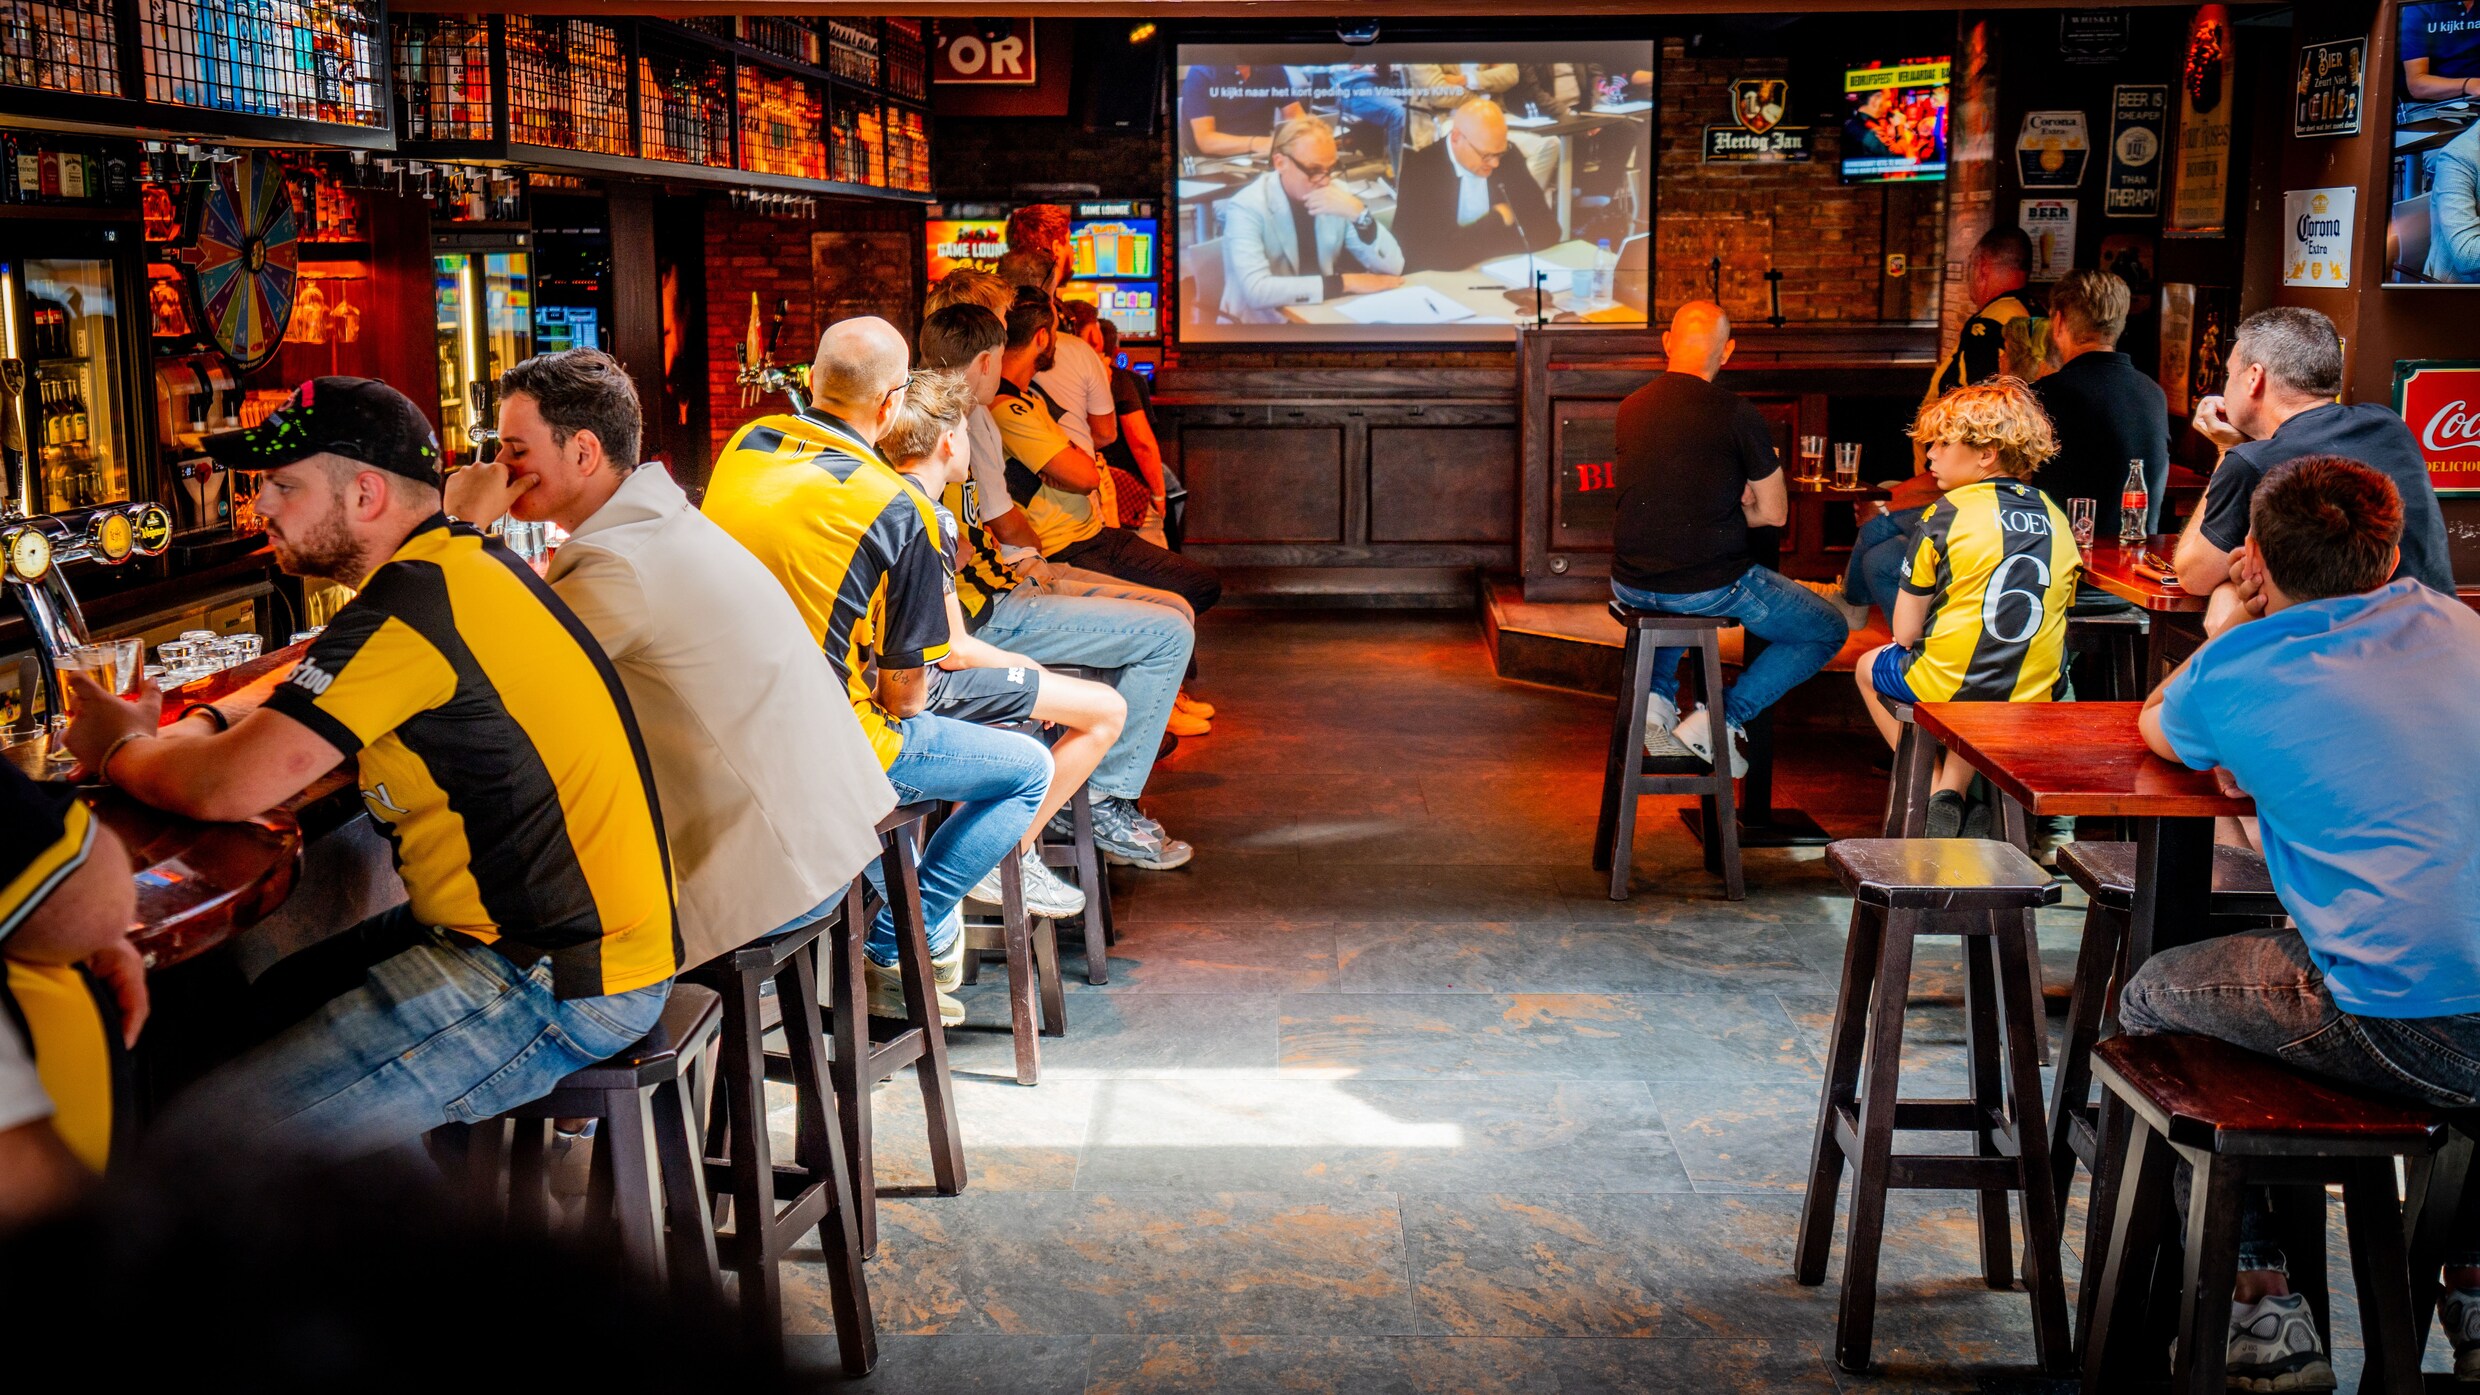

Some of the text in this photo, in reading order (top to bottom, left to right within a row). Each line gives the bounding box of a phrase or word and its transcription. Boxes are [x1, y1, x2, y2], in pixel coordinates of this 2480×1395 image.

[2428, 22, 2437, 33] U
[2440, 20, 2464, 34] kijkt
[1209, 87, 1464, 99] U kijkt naar het kort geding van Vitesse vs KNVB
[2118, 92, 2162, 107] BEER IS
[2030, 116, 2076, 128] Corona
[2118, 111, 2160, 120] CHEAPER
[1713, 132, 1802, 153] Hertog Jan
[2121, 175, 2147, 184] THAN
[2109, 188, 2157, 207] THERAPY
[2029, 208, 2069, 217] BEER
[2297, 213, 2340, 242] Corona
[937, 242, 969, 257] GAME
[2307, 240, 2328, 254] Extra
[1992, 508, 2057, 537] KOEN
[1983, 553, 2051, 643] 6
